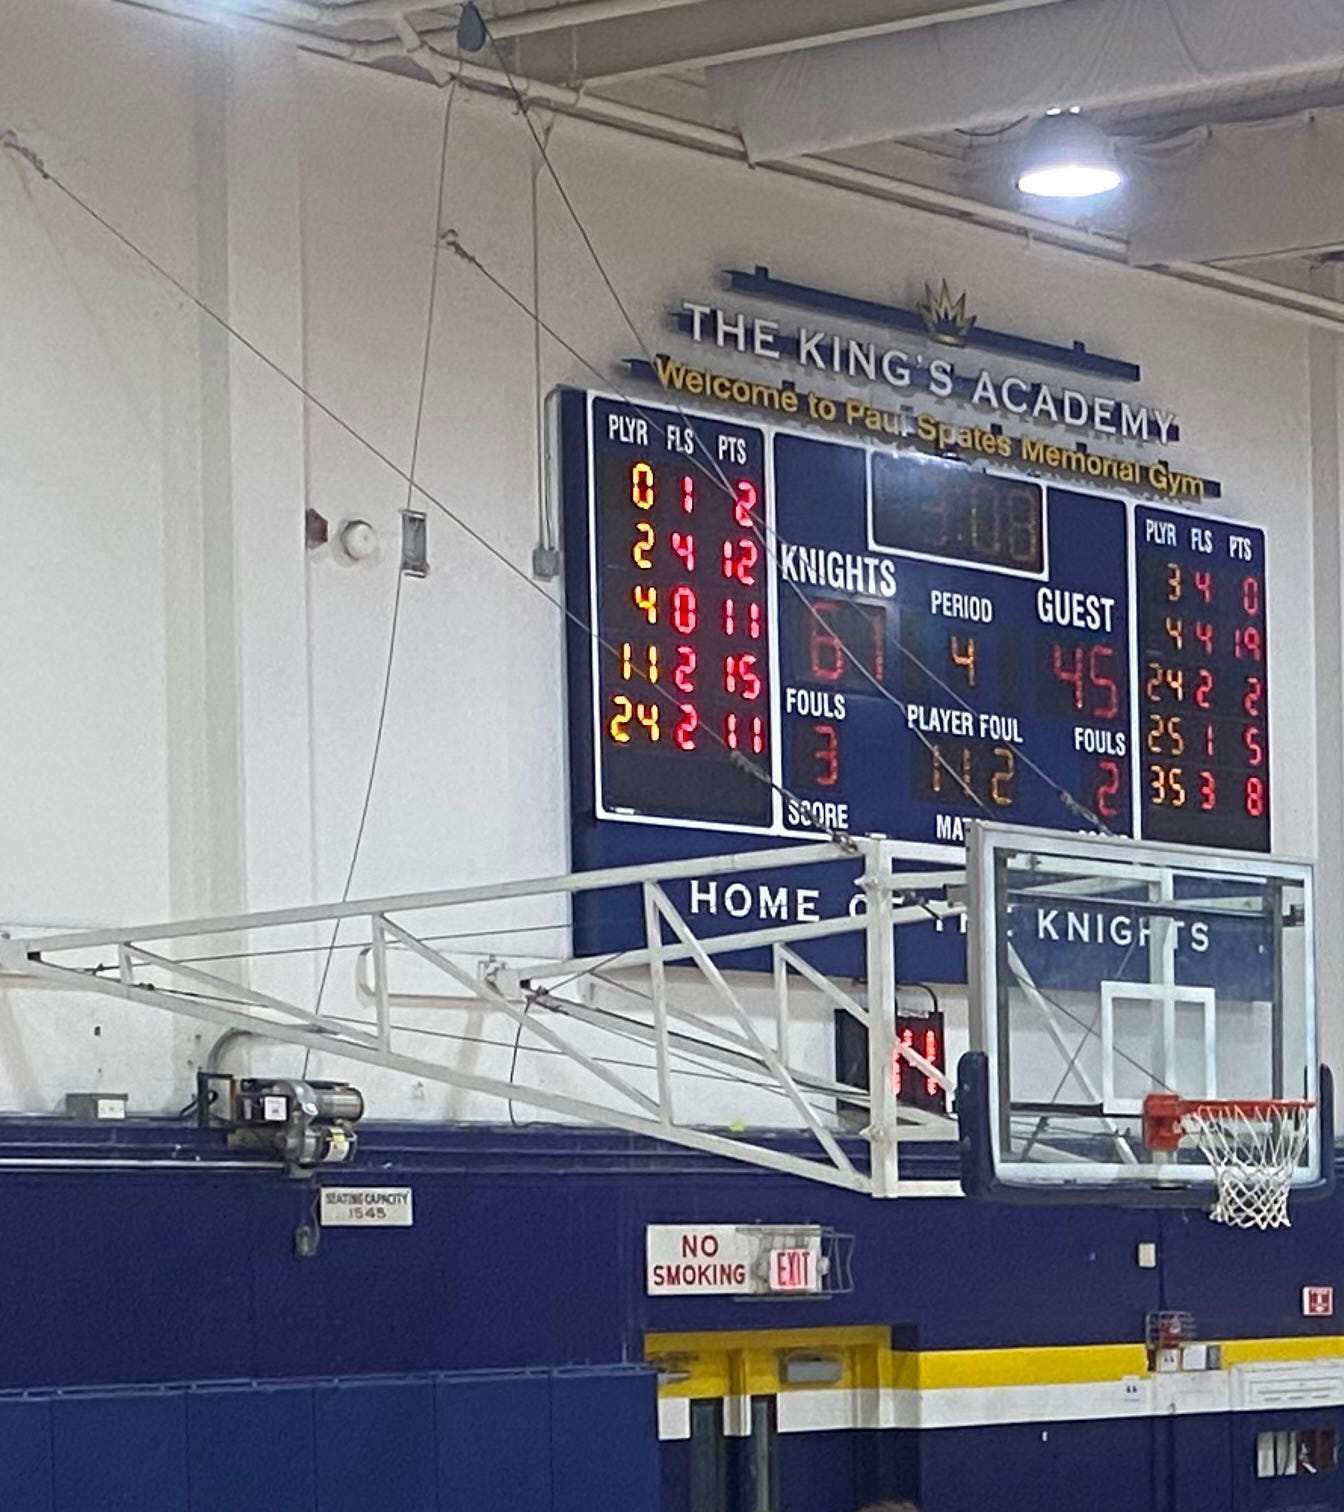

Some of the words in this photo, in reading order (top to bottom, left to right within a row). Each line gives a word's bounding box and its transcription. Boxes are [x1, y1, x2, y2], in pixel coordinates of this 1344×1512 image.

[683, 301, 781, 360] THE
[800, 327, 953, 397] KING'S
[972, 370, 1177, 444] ACADEMY
[608, 413, 649, 446] PLYR
[667, 425, 695, 455] FLS
[718, 435, 747, 464] PTS
[656, 357, 799, 413] Welcome
[808, 392, 836, 421] to
[846, 398, 913, 437] Paul
[917, 416, 1012, 459] Spates
[1022, 437, 1141, 485] Memorial
[1149, 464, 1205, 498] Gym
[632, 462, 654, 510] 0
[683, 476, 694, 513] 1
[735, 481, 757, 527] 2
[633, 522, 655, 569] 2
[672, 532, 694, 571] 4
[723, 538, 758, 585] 12
[1146, 519, 1177, 547] PLYR
[1191, 528, 1213, 553] FLS
[1229, 535, 1252, 560] PTS
[781, 544, 897, 598] KNIGHTS
[1167, 563, 1181, 601] 3
[1194, 571, 1211, 603] 4
[1243, 577, 1258, 615] 0
[634, 585, 657, 624] 4
[673, 586, 697, 634] 0
[725, 599, 760, 639] 11
[931, 590, 993, 623] PERIOD
[1037, 587, 1115, 632] GUEST
[951, 635, 976, 687] 4
[1166, 617, 1183, 650] 4
[1195, 621, 1213, 655] 4
[622, 642, 659, 683] 11
[674, 646, 697, 693] 2
[726, 653, 761, 700] 15
[1053, 644, 1118, 718] 45
[1147, 663, 1183, 701] 24
[1195, 669, 1212, 708] 2
[1244, 677, 1261, 717] 2
[610, 695, 660, 742] 24
[676, 703, 698, 750] 2
[727, 713, 763, 753] 11
[786, 688, 846, 720] FOULS
[908, 704, 974, 737] PLAYER
[979, 714, 1024, 743] FOUL
[815, 725, 838, 786] 3
[1074, 727, 1126, 756] FOULS
[1148, 714, 1184, 756] 25
[1207, 724, 1213, 756] 1
[1244, 727, 1262, 767] 5
[788, 800, 849, 829] SCORE
[1097, 761, 1120, 817] 2
[1151, 765, 1186, 806] 35
[1201, 771, 1216, 810] 3
[1246, 777, 1263, 816] 8
[690, 880, 820, 922] HOME
[682, 1235, 719, 1258] NO
[777, 1252, 810, 1287] EXIT
[653, 1264, 746, 1286] SMOKING
